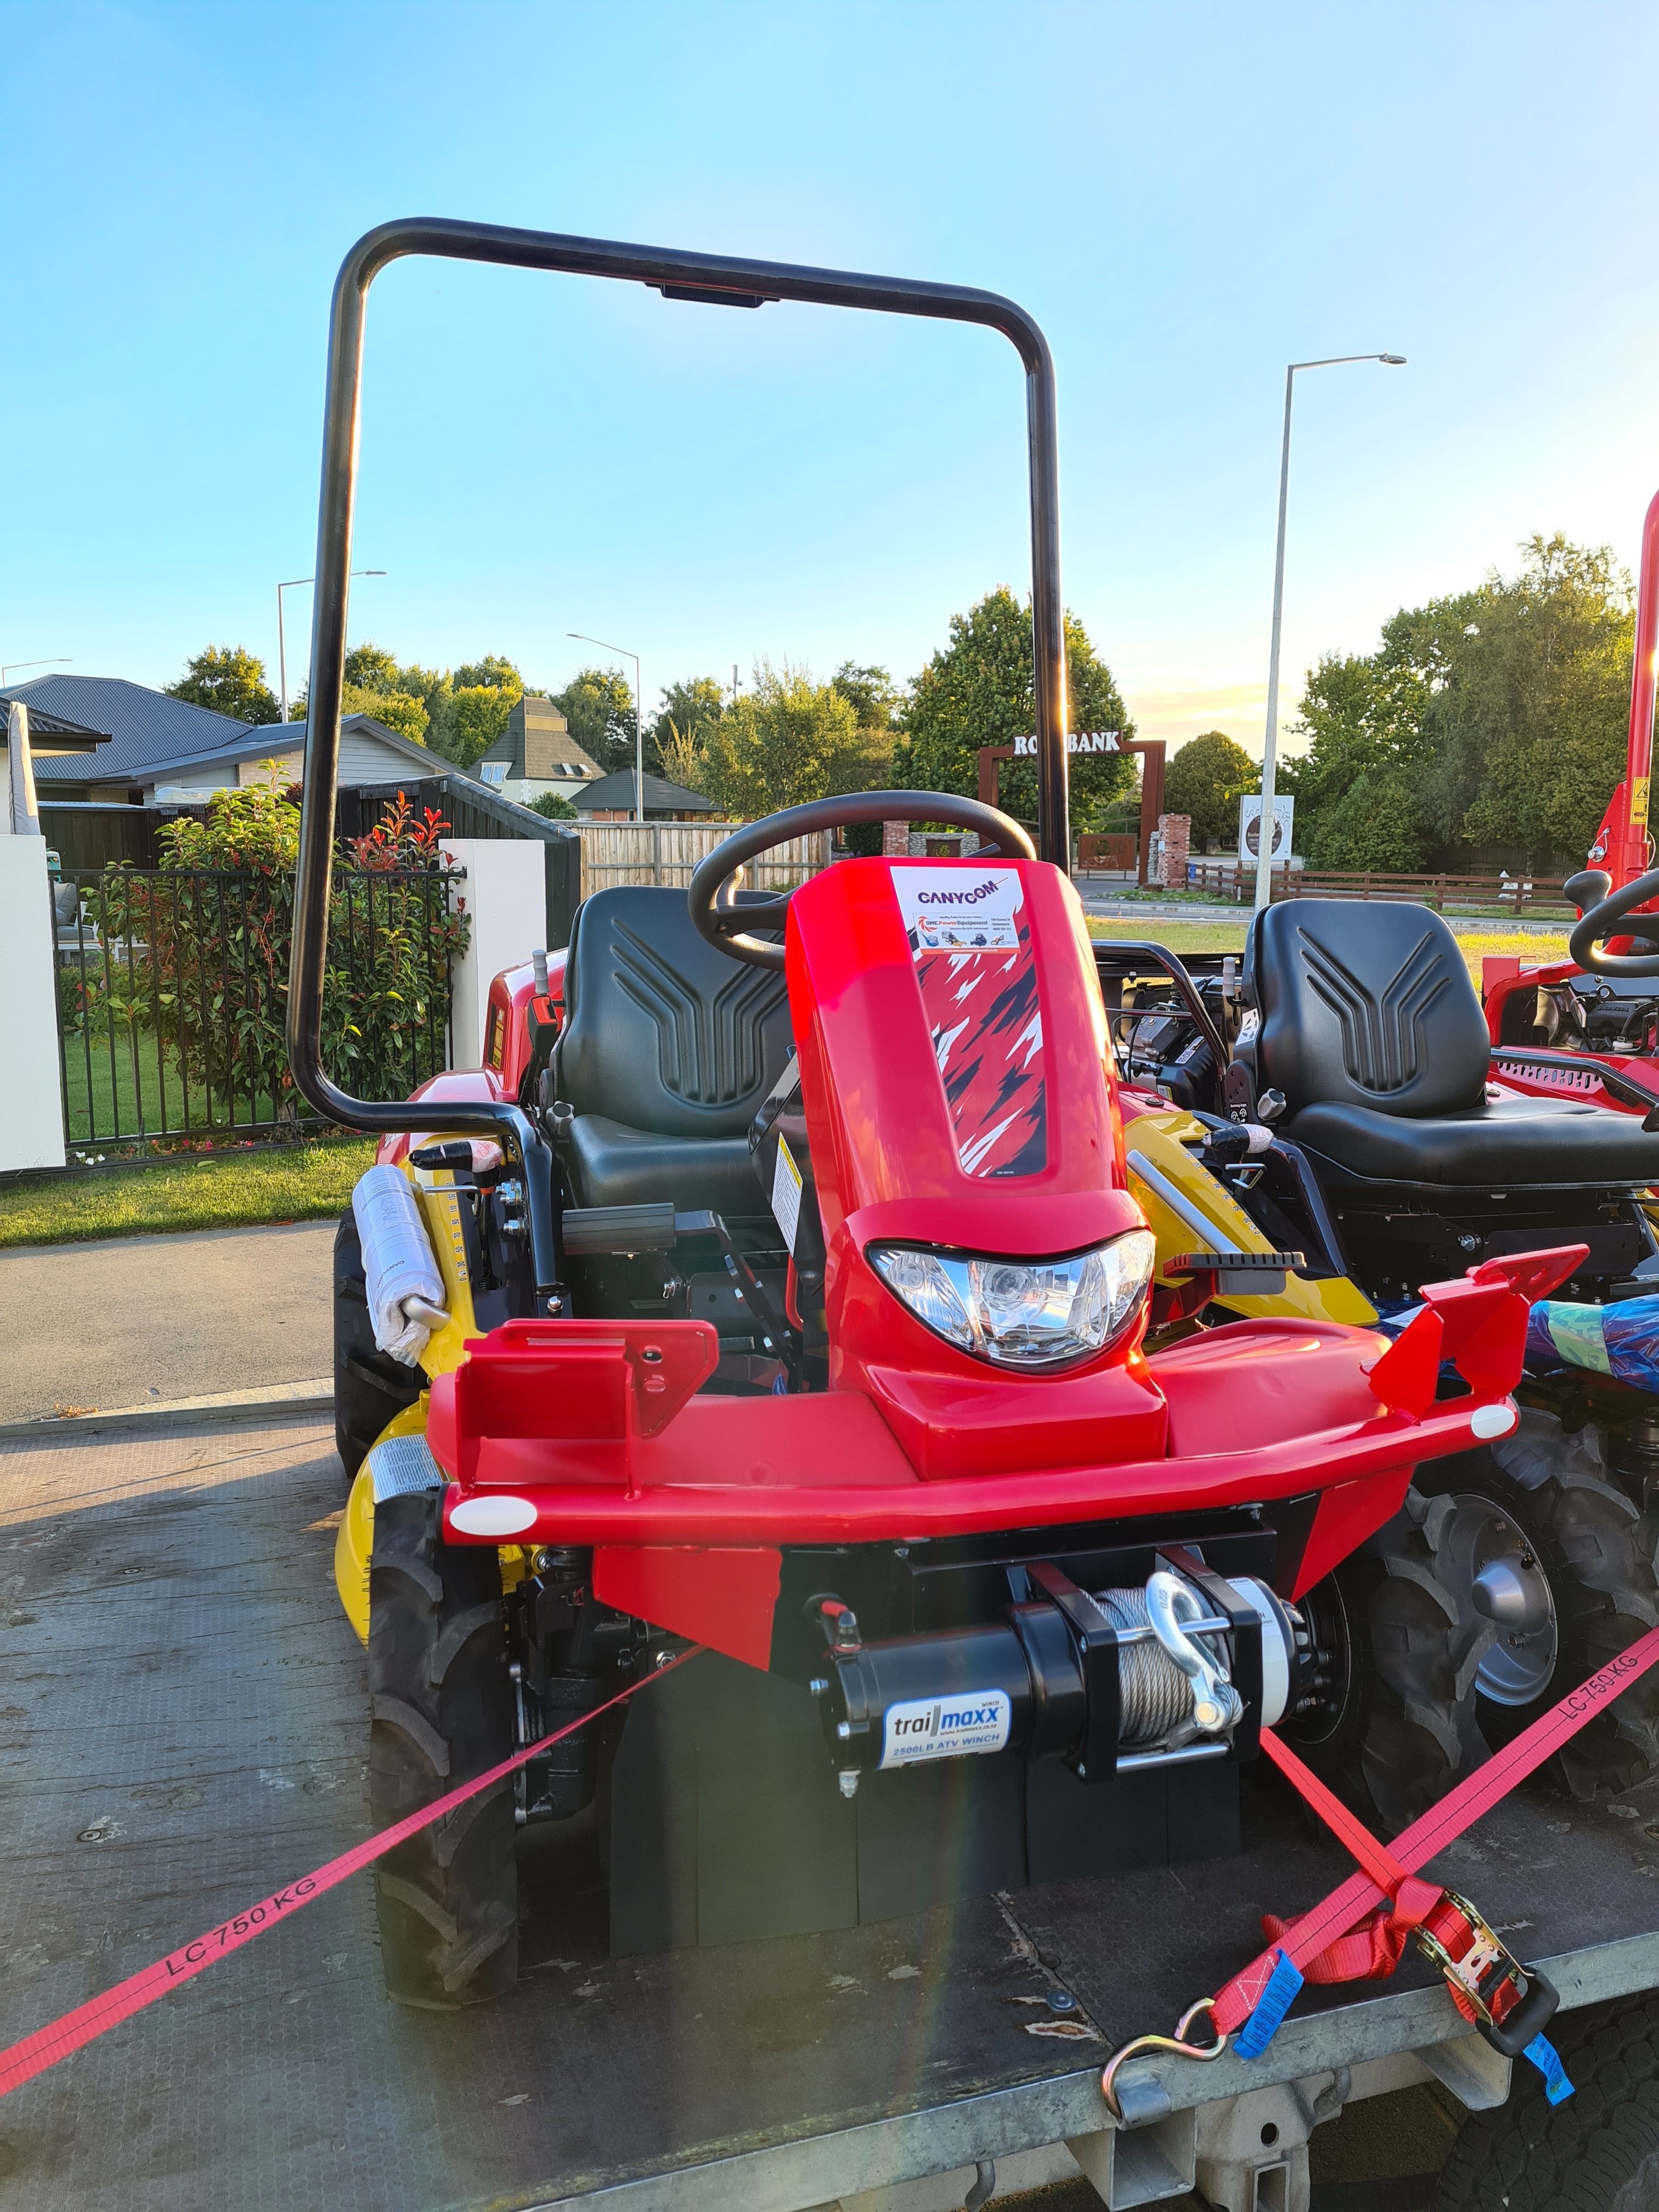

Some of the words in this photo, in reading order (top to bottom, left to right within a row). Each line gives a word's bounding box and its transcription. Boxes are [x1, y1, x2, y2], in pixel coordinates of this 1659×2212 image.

[1014, 731, 1120, 755] ROBANK
[918, 880, 1000, 904] CANYCOM
[1558, 1697, 1587, 1720] LC
[1580, 1674, 1615, 1700] 750
[1607, 1655, 1638, 1677] KG
[893, 1743, 933, 1756] 2500LB
[936, 1740, 959, 1750] ATV
[962, 1734, 1000, 1746] WINCH
[165, 1942, 206, 1976] LC
[213, 1907, 266, 1946] 750
[273, 1878, 317, 1910] KG
